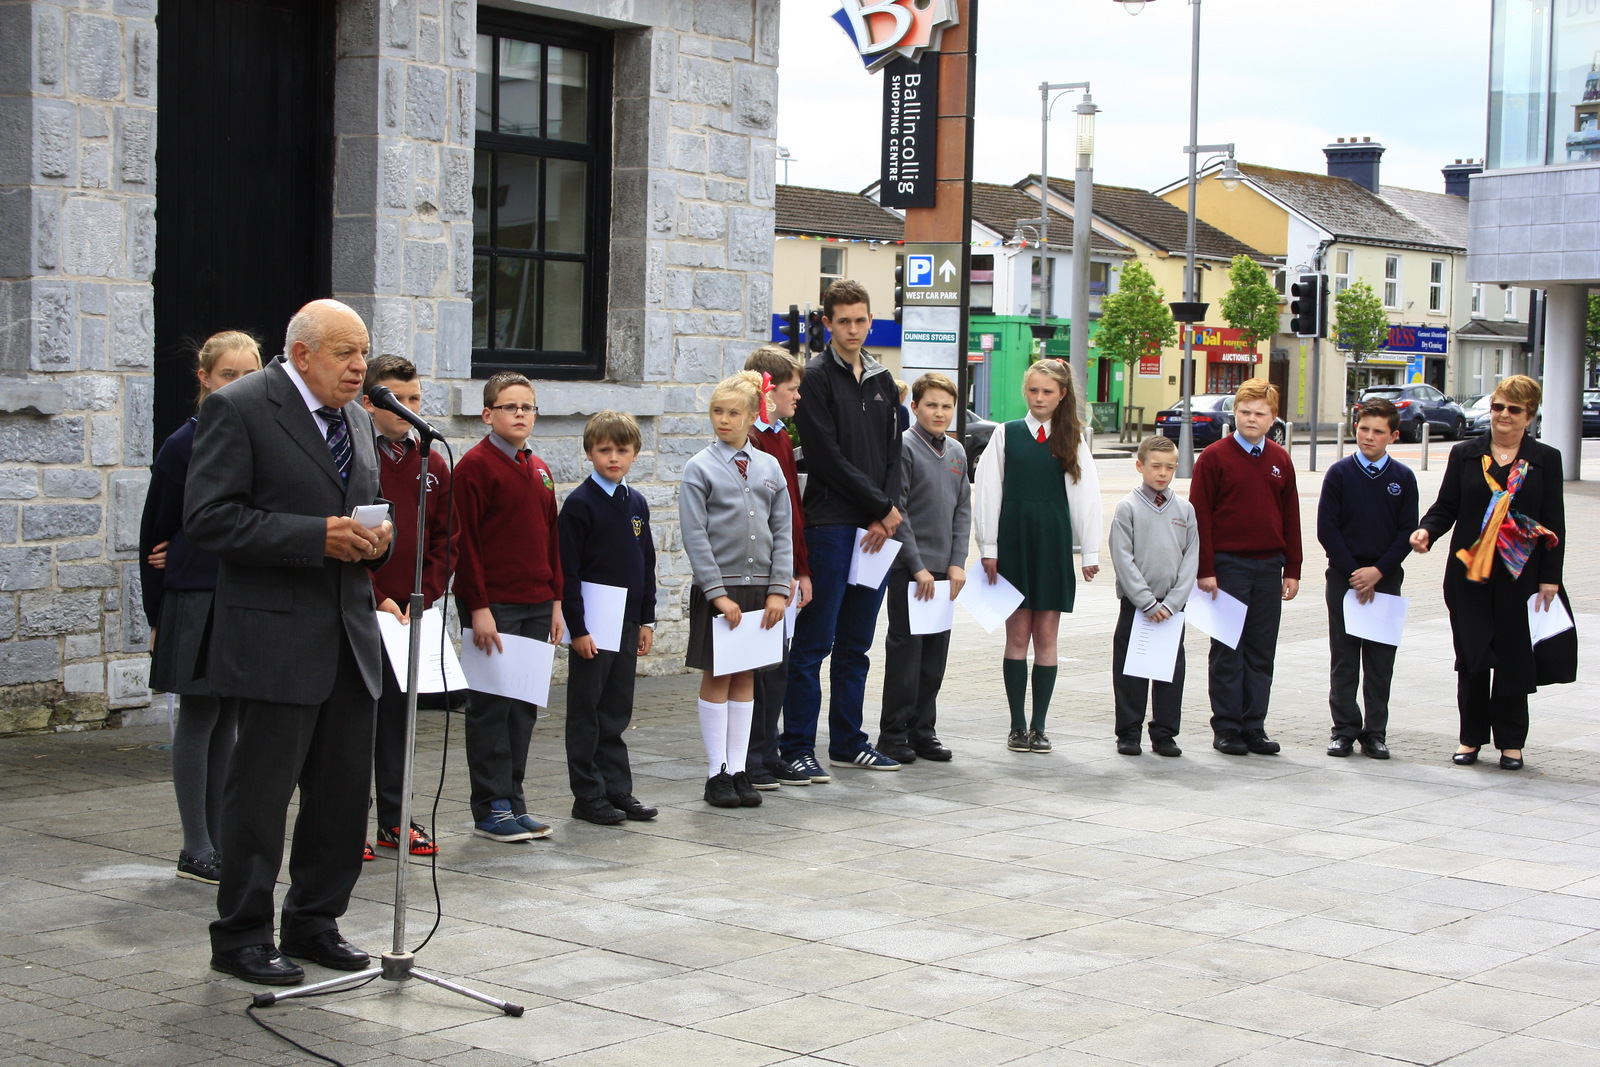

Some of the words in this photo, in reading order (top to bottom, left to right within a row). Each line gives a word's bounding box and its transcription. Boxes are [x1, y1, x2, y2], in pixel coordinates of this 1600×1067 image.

[890, 75, 901, 135] SHOPPING
[898, 74, 921, 194] Ballincollig
[889, 138, 898, 181] CENTRE
[909, 258, 931, 283] P
[905, 291, 925, 300] WEST
[925, 291, 939, 300] CAR
[940, 291, 957, 300] PARK
[904, 333, 930, 341] DUNNES
[931, 333, 955, 341] STORES
[1384, 328, 1415, 347] RESS
